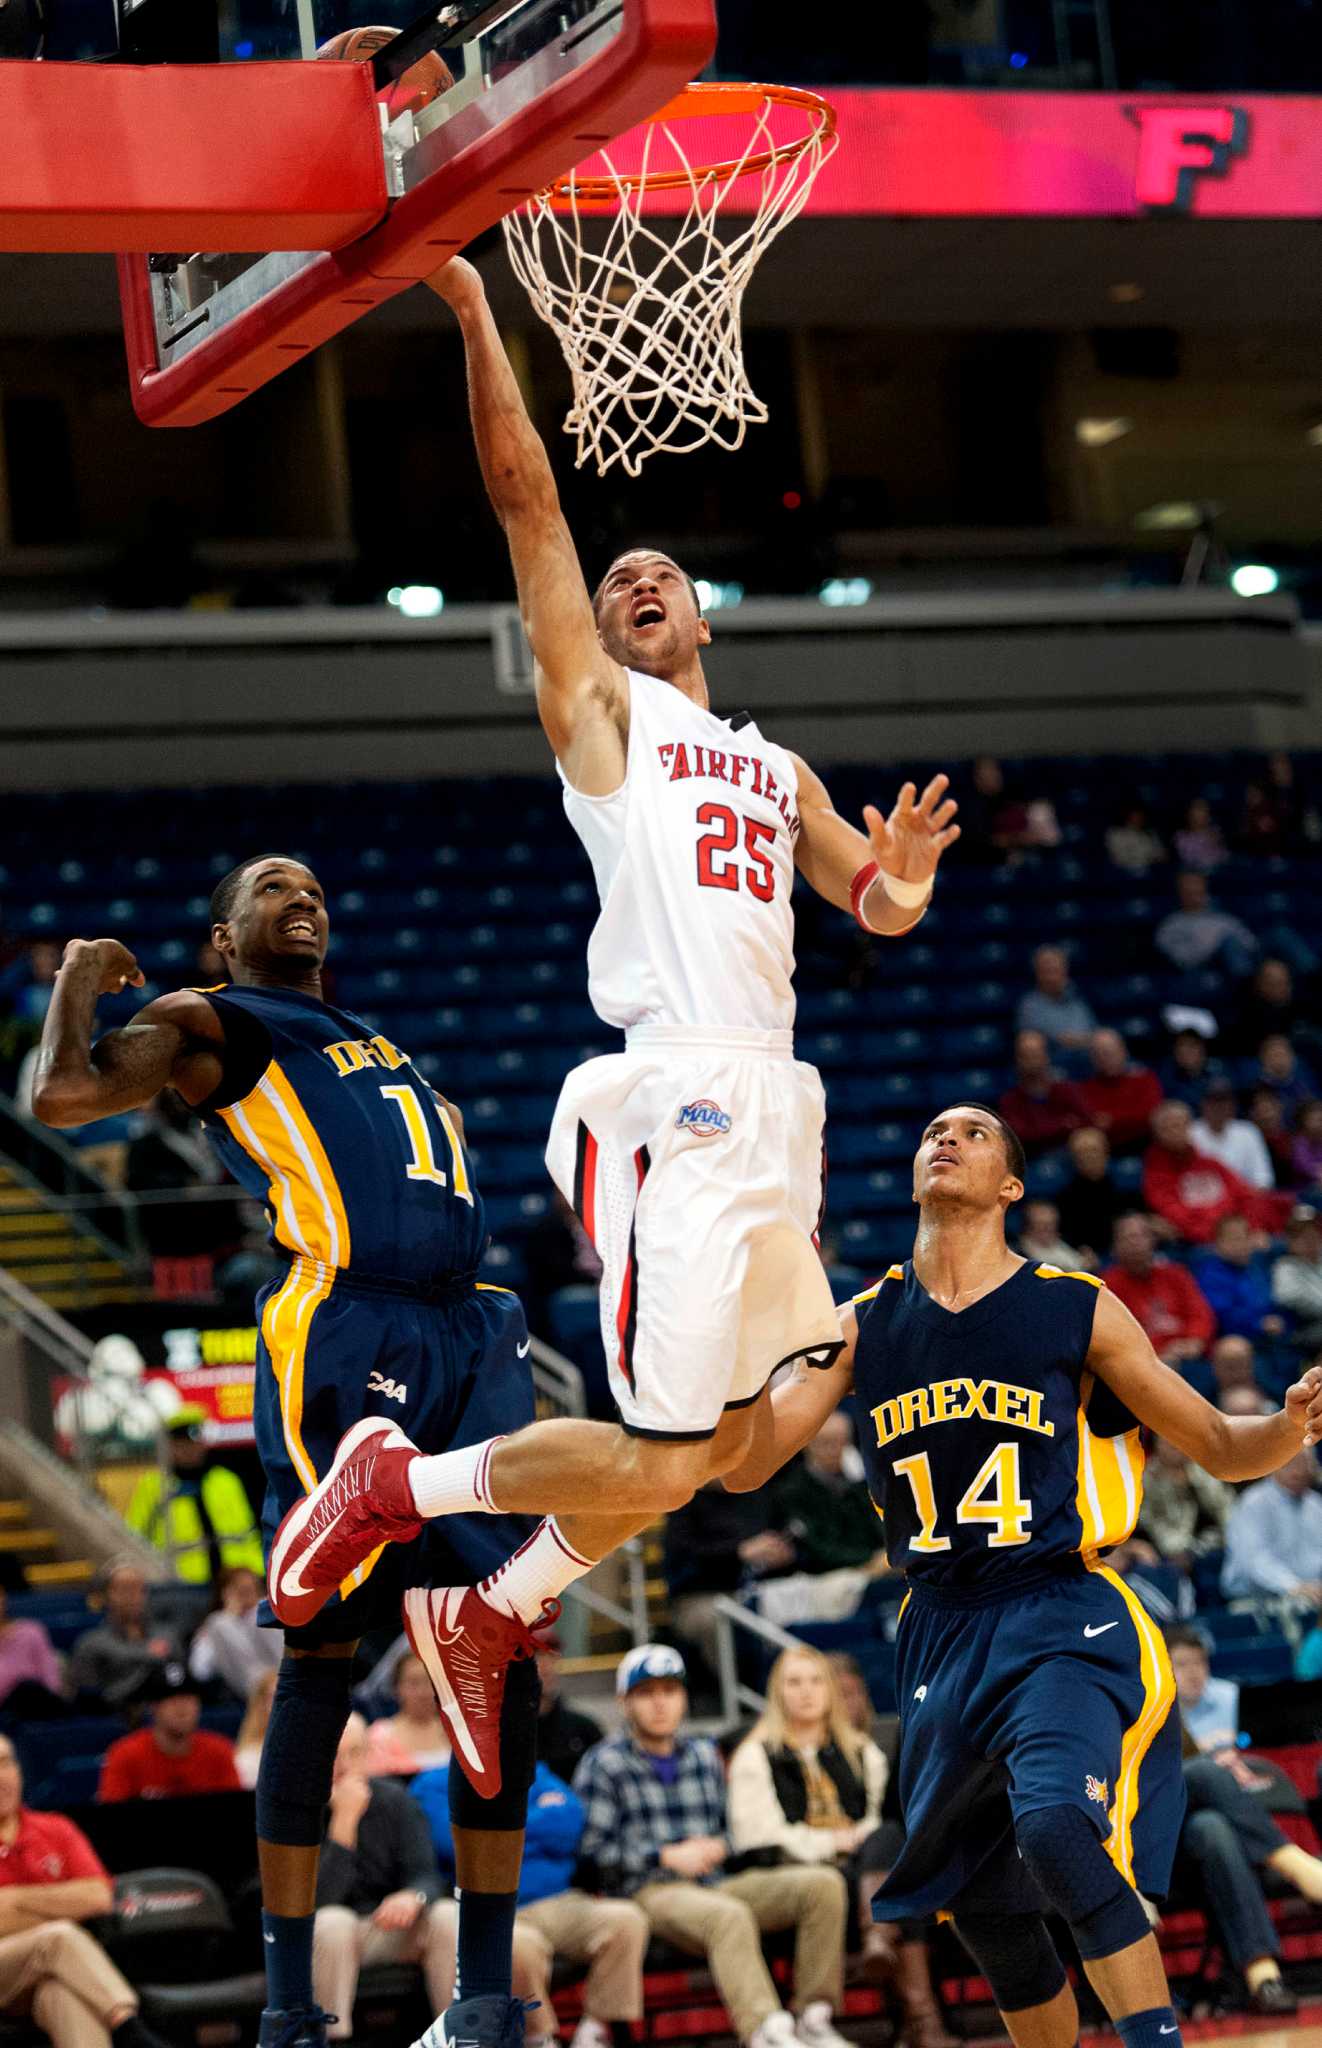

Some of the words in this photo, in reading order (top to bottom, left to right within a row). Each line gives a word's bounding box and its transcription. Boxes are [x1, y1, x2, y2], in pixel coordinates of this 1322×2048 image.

[696, 802, 777, 903] 25
[379, 1084, 475, 1208] 11
[675, 1106, 731, 1133] MAAC
[870, 1378, 1055, 1448] DREXEL
[892, 1442, 1033, 1553] 14
